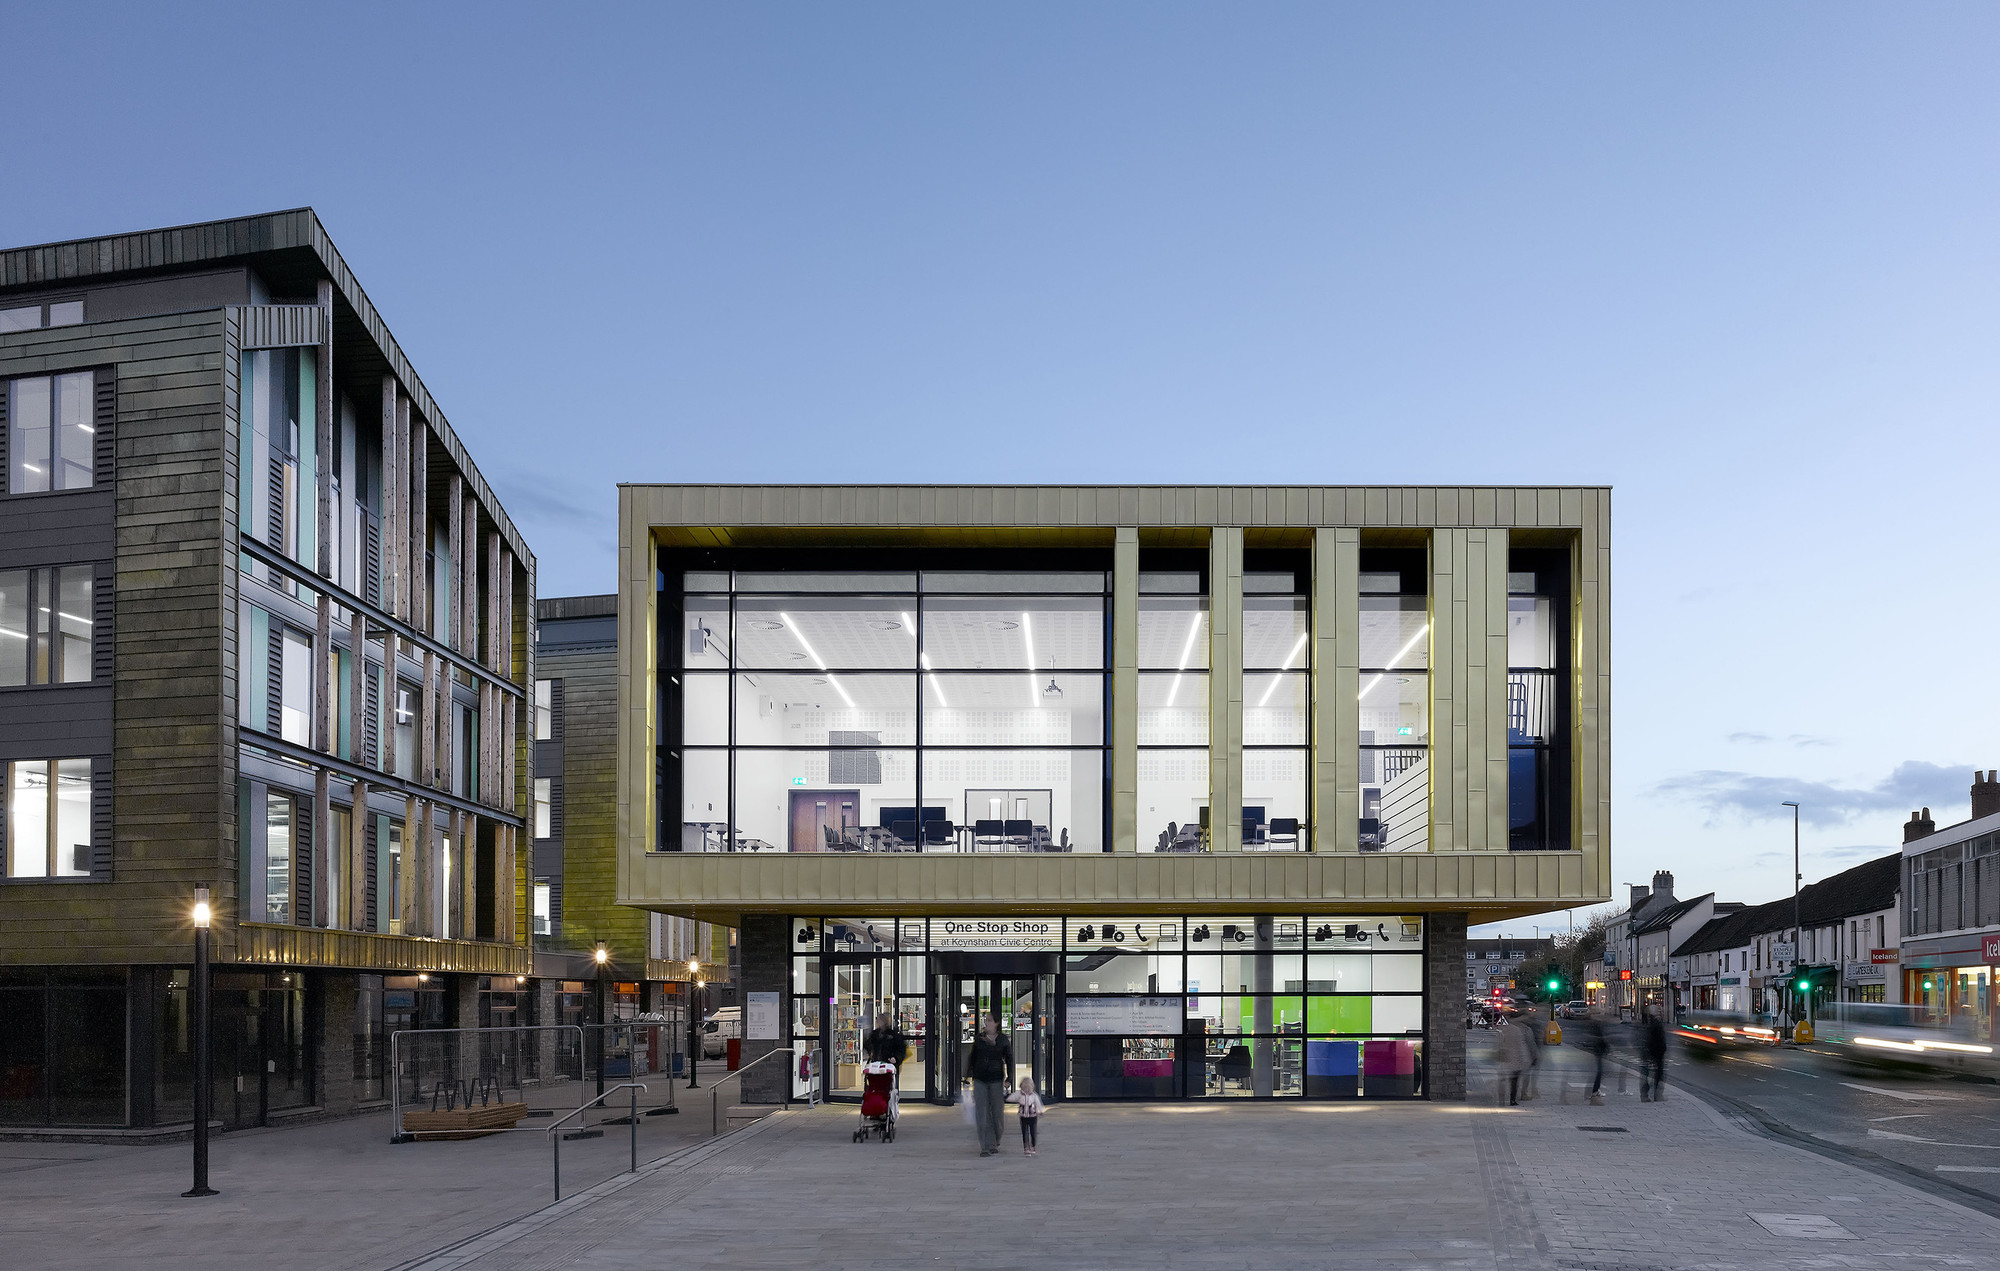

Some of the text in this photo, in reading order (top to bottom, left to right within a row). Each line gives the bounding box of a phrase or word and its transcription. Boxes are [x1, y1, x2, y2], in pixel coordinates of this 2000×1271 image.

[945, 921, 1049, 935] One Stop Shop
[941, 938, 1052, 947] at Keynsham Civic Centre
